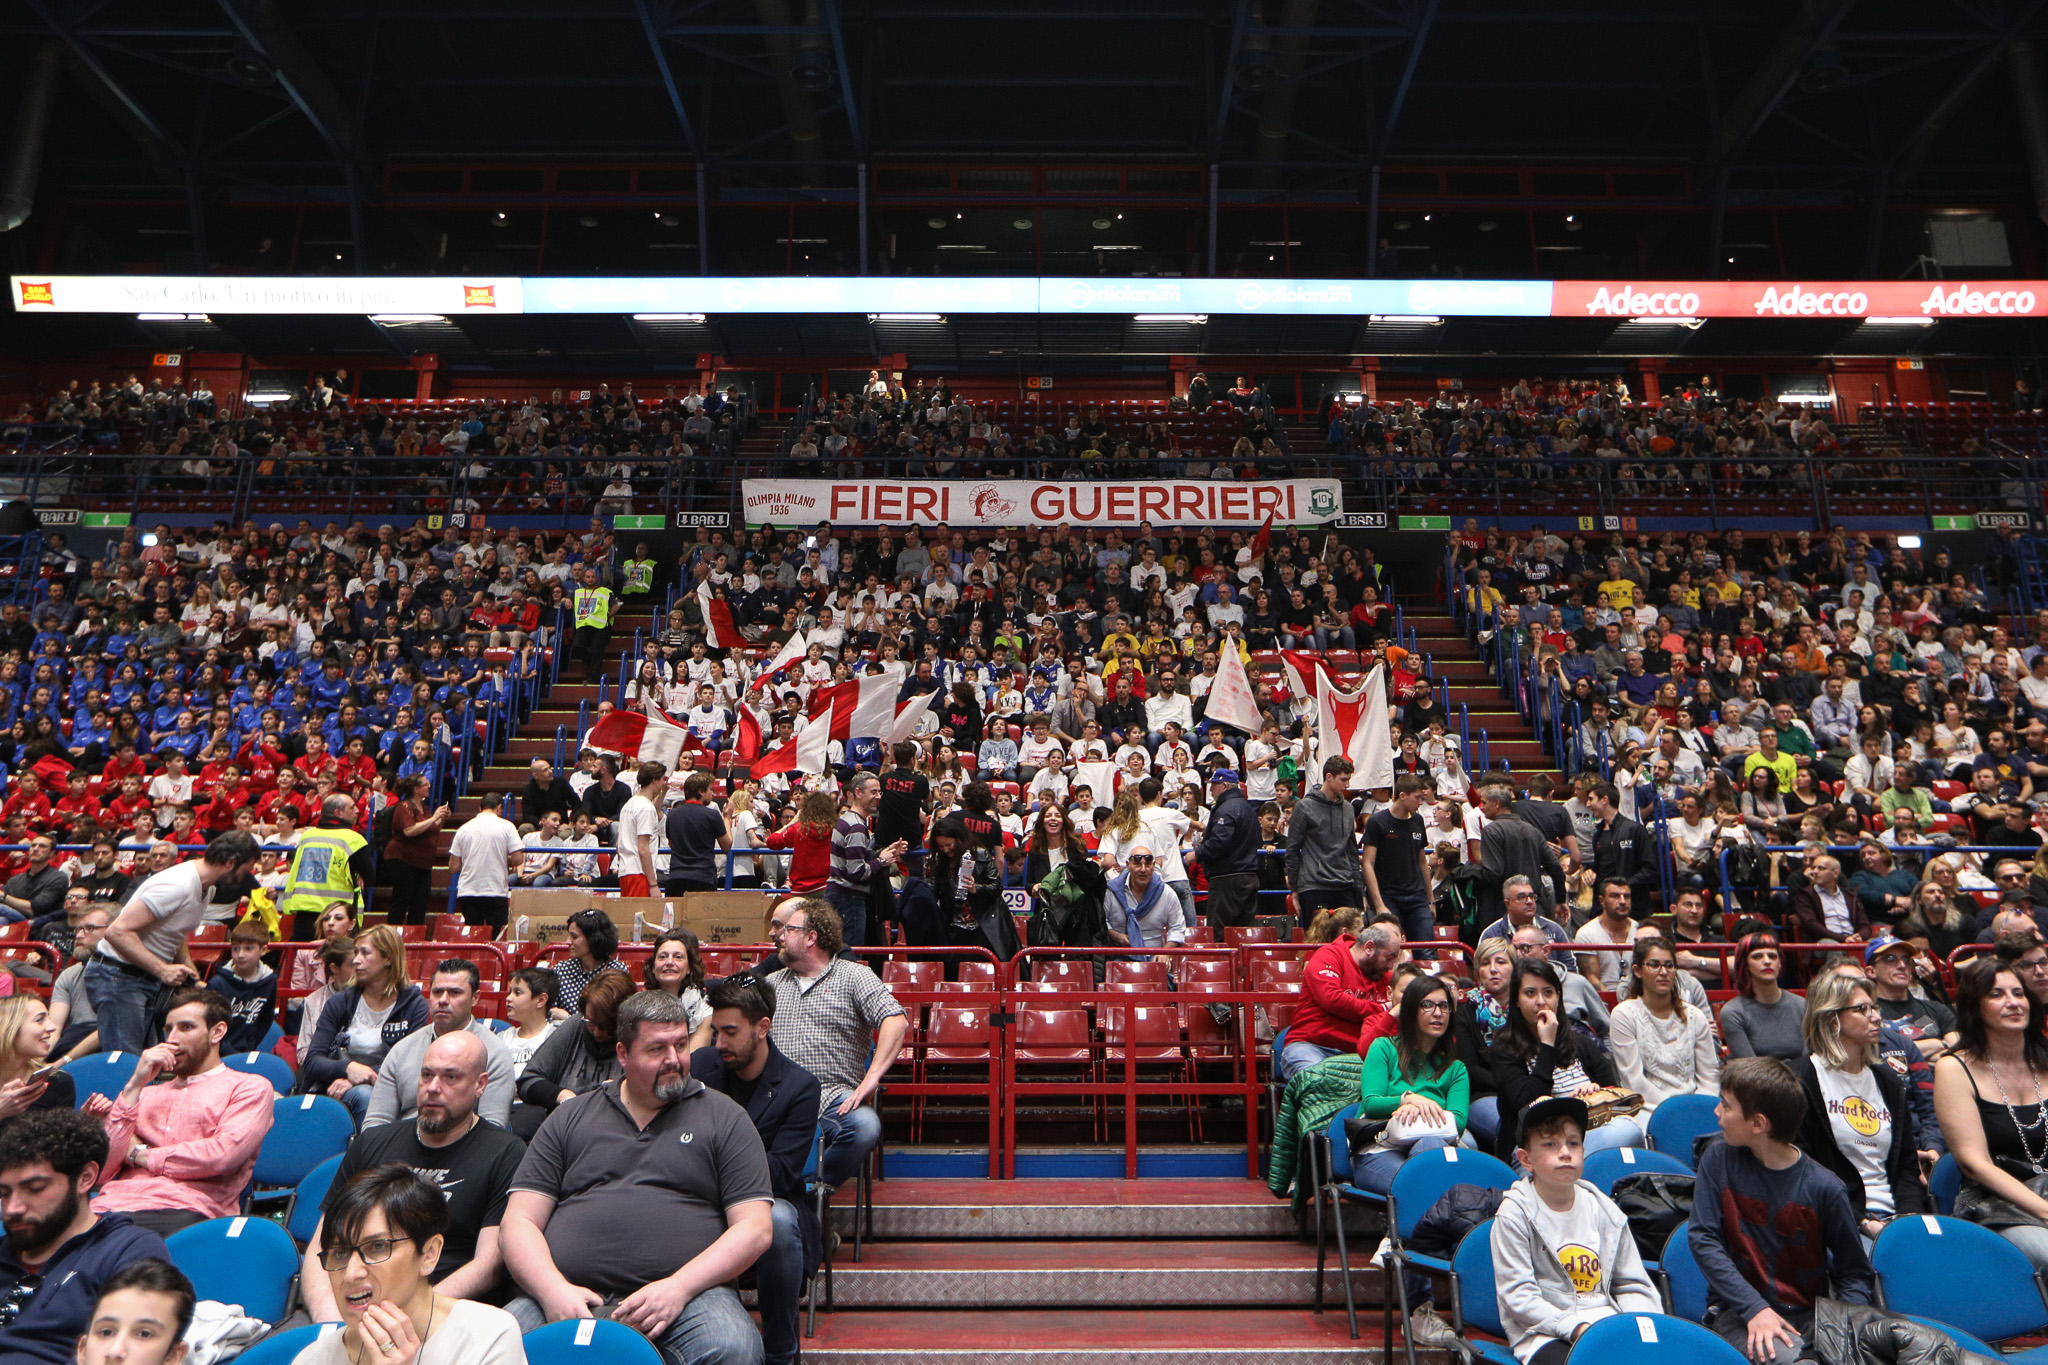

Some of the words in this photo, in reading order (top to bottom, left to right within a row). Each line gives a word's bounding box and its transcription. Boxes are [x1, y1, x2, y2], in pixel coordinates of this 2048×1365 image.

[27, 286, 46, 294] SAN
[123, 284, 157, 303] San
[263, 285, 329, 303] motivo
[335, 286, 353, 303] in
[470, 289, 489, 297] SAN
[1067, 284, 1180, 304] mediolanum
[1239, 284, 1353, 305] mediolanum
[23, 293, 52, 302] CARLO
[466, 296, 494, 304] CARLO
[1586, 285, 1699, 315] Adecco
[1754, 285, 1868, 315] Adecco
[1921, 284, 2036, 314] Adecco
[169, 356, 179, 364] 27
[747, 494, 781, 508] OLIMPIA
[784, 493, 816, 508] MILANO
[830, 485, 950, 521] FIERI
[1030, 485, 1296, 521] GUERRIERI
[1318, 494, 1328, 504] 10
[769, 504, 790, 516] 1936
[40, 512, 66, 522] BAR
[452, 516, 464, 525] 28
[690, 515, 716, 525] BAR
[1349, 515, 1374, 526] BAR
[1990, 515, 2016, 526] BAR
[1605, 518, 1618, 528] 30
[885, 777, 916, 793] STAFF
[963, 817, 993, 835] STAFF
[1003, 892, 1026, 908] 29
[1828, 1099, 1858, 1117] Hard
[1859, 1105, 1892, 1124] Rock
[1856, 1121, 1873, 1130] CAFE
[1854, 1139, 1878, 1148] LONDON
[1572, 1278, 1591, 1289] AFE
